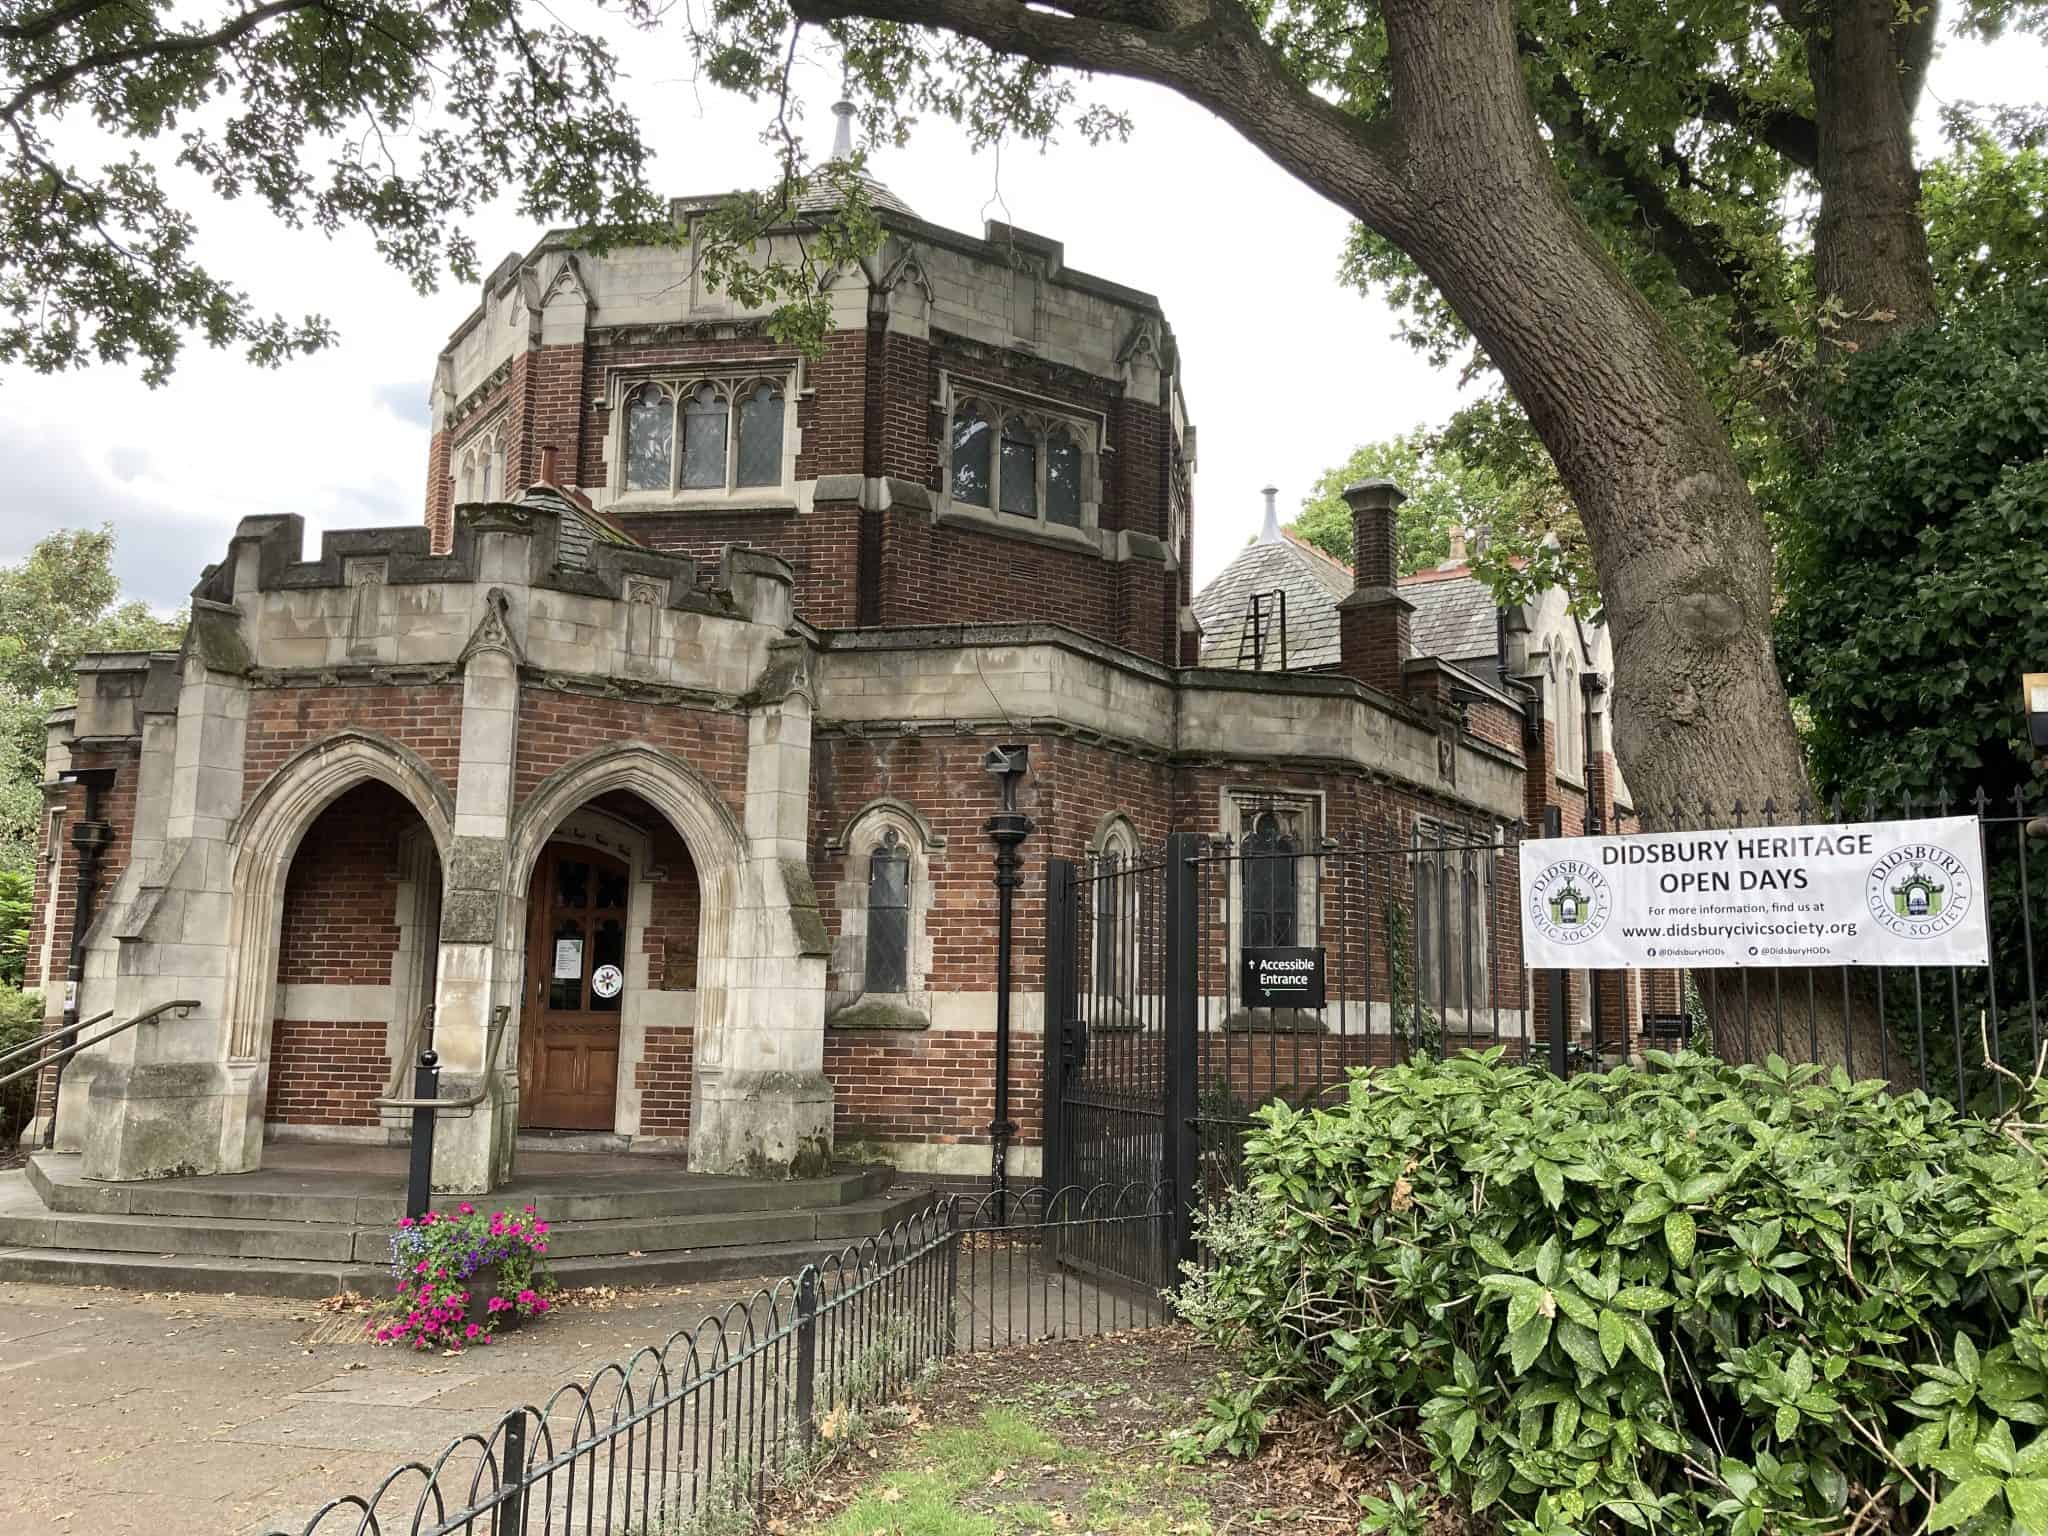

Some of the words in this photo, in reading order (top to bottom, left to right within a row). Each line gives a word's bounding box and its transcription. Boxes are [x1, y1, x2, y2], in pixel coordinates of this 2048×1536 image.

[1602, 839, 1729, 865] DIDSBURY
[1738, 834, 1873, 860] HERITAGE
[1869, 846, 1965, 881] DIDSBURY
[1534, 861, 1608, 892] DIDSBURY
[1660, 871, 1730, 893] OPEN
[1740, 868, 1808, 890] DAYS
[1532, 903, 1559, 938] CIVIC
[1561, 903, 1608, 942] SOCIETY
[1648, 906, 1665, 916] For
[1668, 907, 1697, 915] more
[1699, 903, 1769, 915] information,
[1772, 902, 1794, 912] find
[1797, 904, 1810, 912] us
[1813, 903, 1825, 912] at
[1870, 895, 1905, 932] CIVIC
[1909, 892, 1967, 936] SOCIETY
[1622, 921, 1857, 939] www.didsburycivicsociety.org
[1259, 958, 1315, 970] Accessible
[1260, 973, 1308, 985] Entrance
